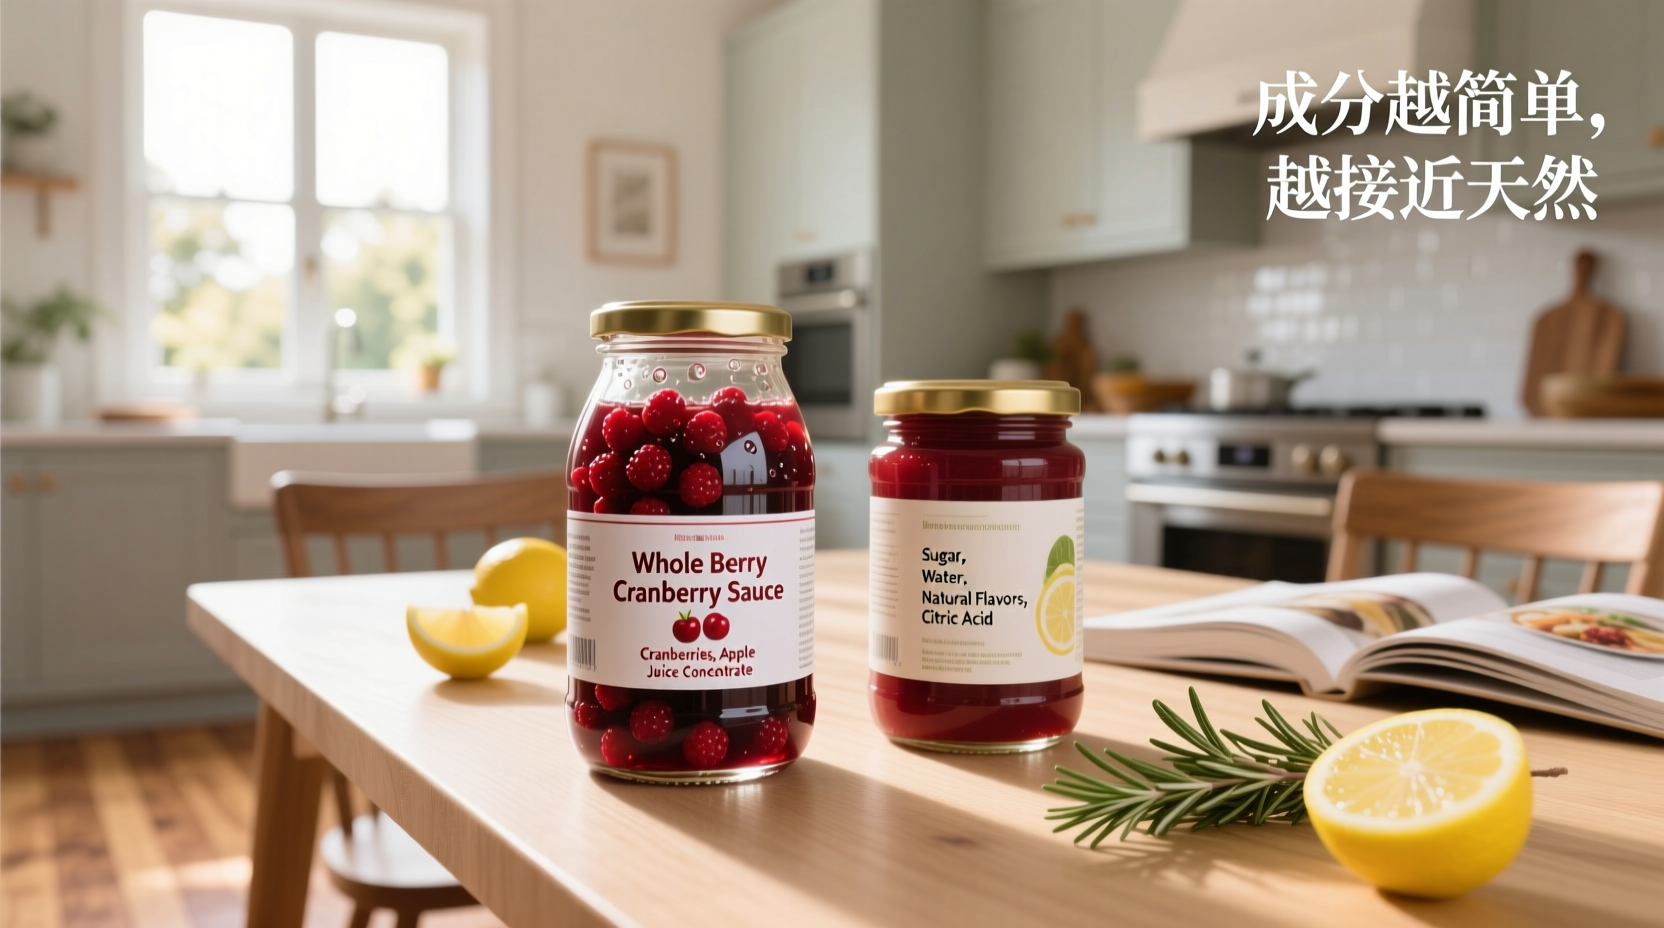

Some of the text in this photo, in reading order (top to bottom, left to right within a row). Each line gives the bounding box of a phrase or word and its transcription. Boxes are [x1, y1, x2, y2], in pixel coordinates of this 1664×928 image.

[632, 551, 768, 579] Whole Berry
[922, 547, 967, 567] Sugar,
[922, 569, 968, 586] Water,
[613, 580, 784, 609] Cranberry Sauce
[922, 590, 1028, 608] Natural Flavors,
[922, 609, 993, 626] Citric Acid
[640, 645, 756, 663] Cranberries, Apple
[646, 664, 679, 678] Juice
